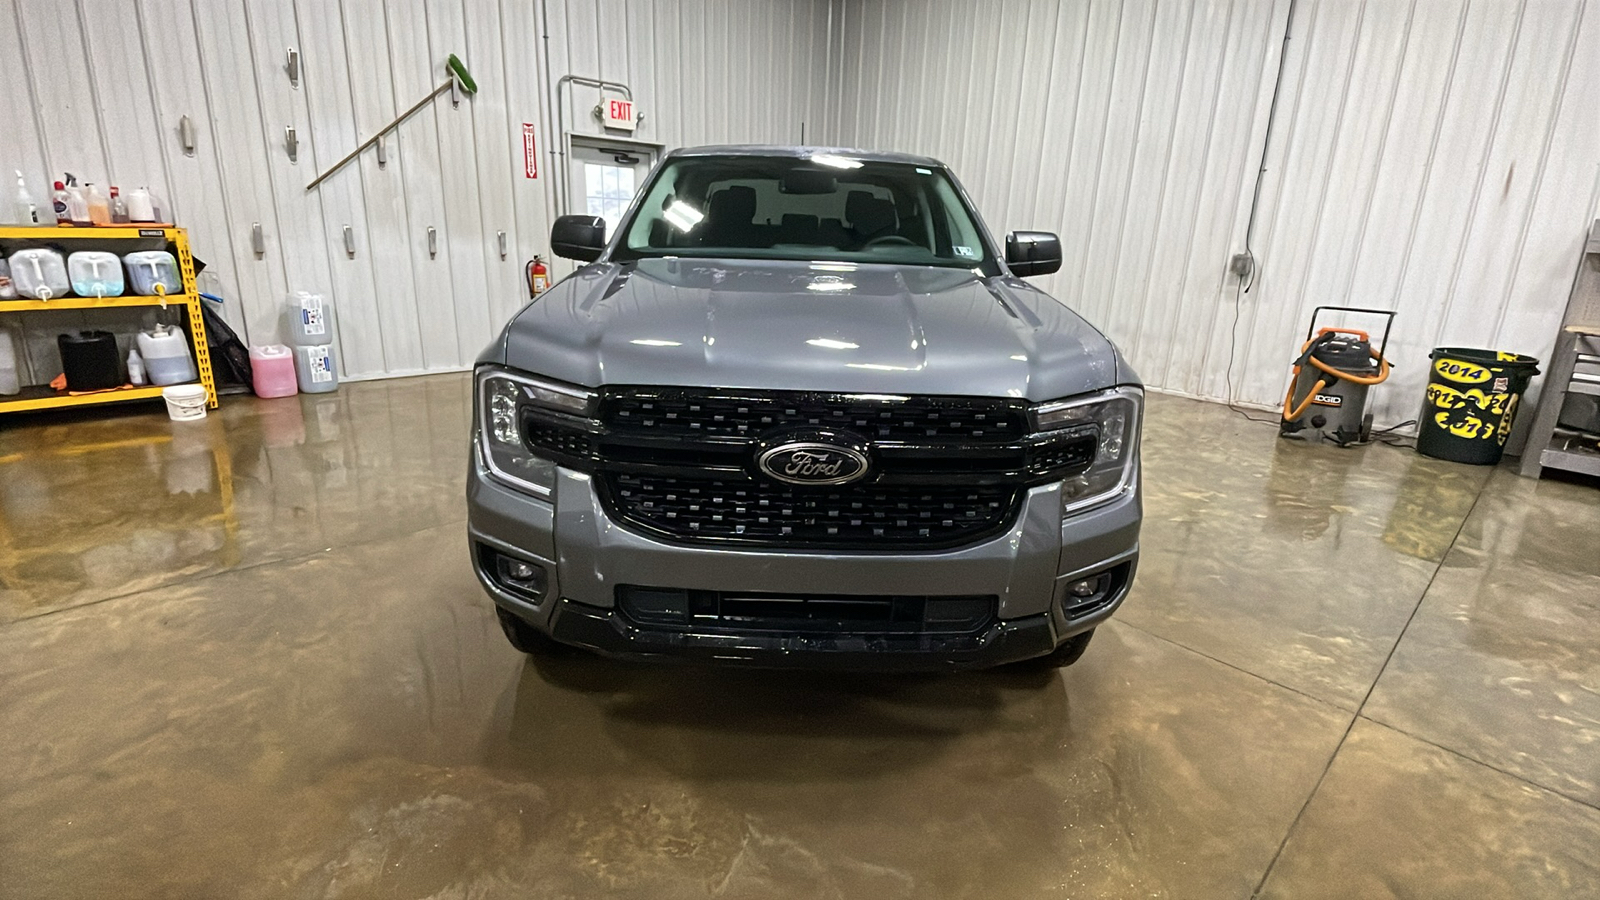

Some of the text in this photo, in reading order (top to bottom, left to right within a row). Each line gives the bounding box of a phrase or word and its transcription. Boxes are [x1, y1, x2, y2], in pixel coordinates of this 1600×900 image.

[610, 100, 632, 121] EXIT
[1439, 361, 1483, 380] 2014
[1314, 394, 1341, 404] IDGID
[785, 451, 843, 476] Ford
